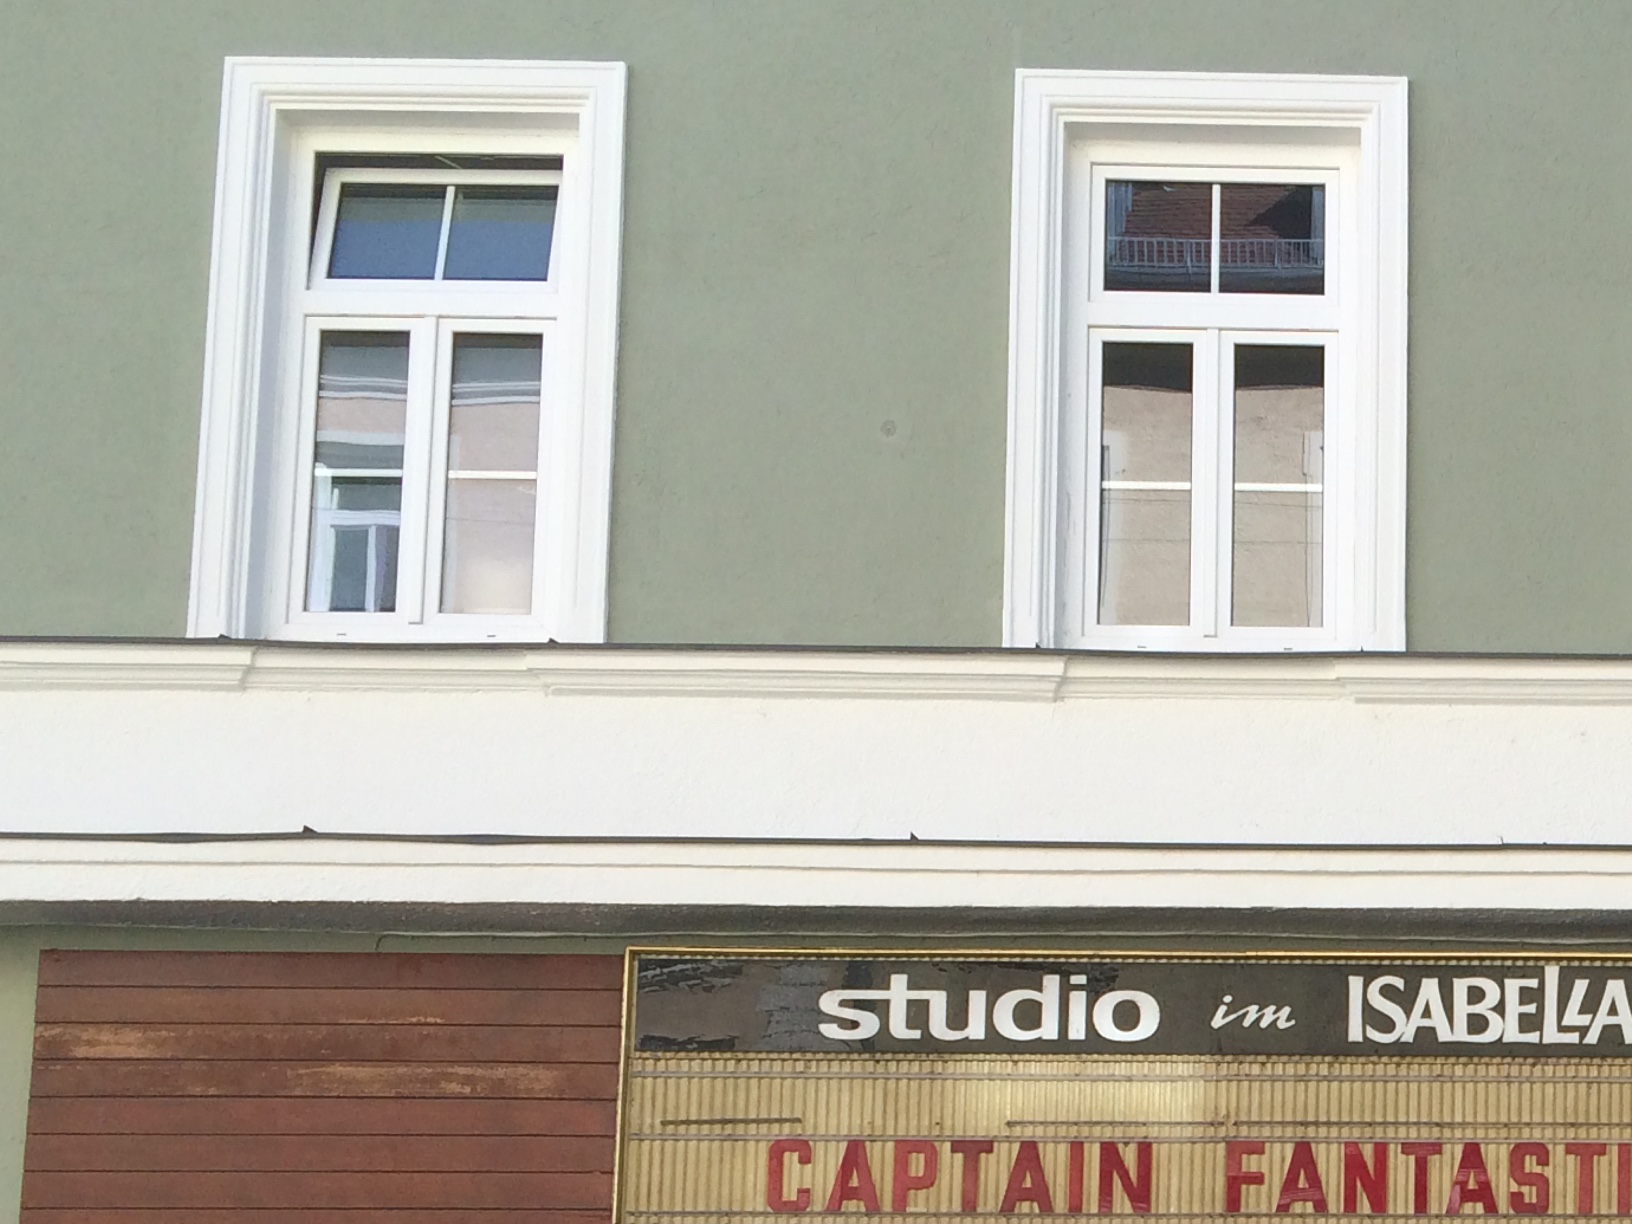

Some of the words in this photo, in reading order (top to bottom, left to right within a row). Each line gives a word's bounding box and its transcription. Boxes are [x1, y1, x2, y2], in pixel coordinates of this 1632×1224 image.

[818, 974, 1160, 1041] studio
[1210, 995, 1295, 1029] im
[767, 1138, 1152, 1213] CAPTAIN
